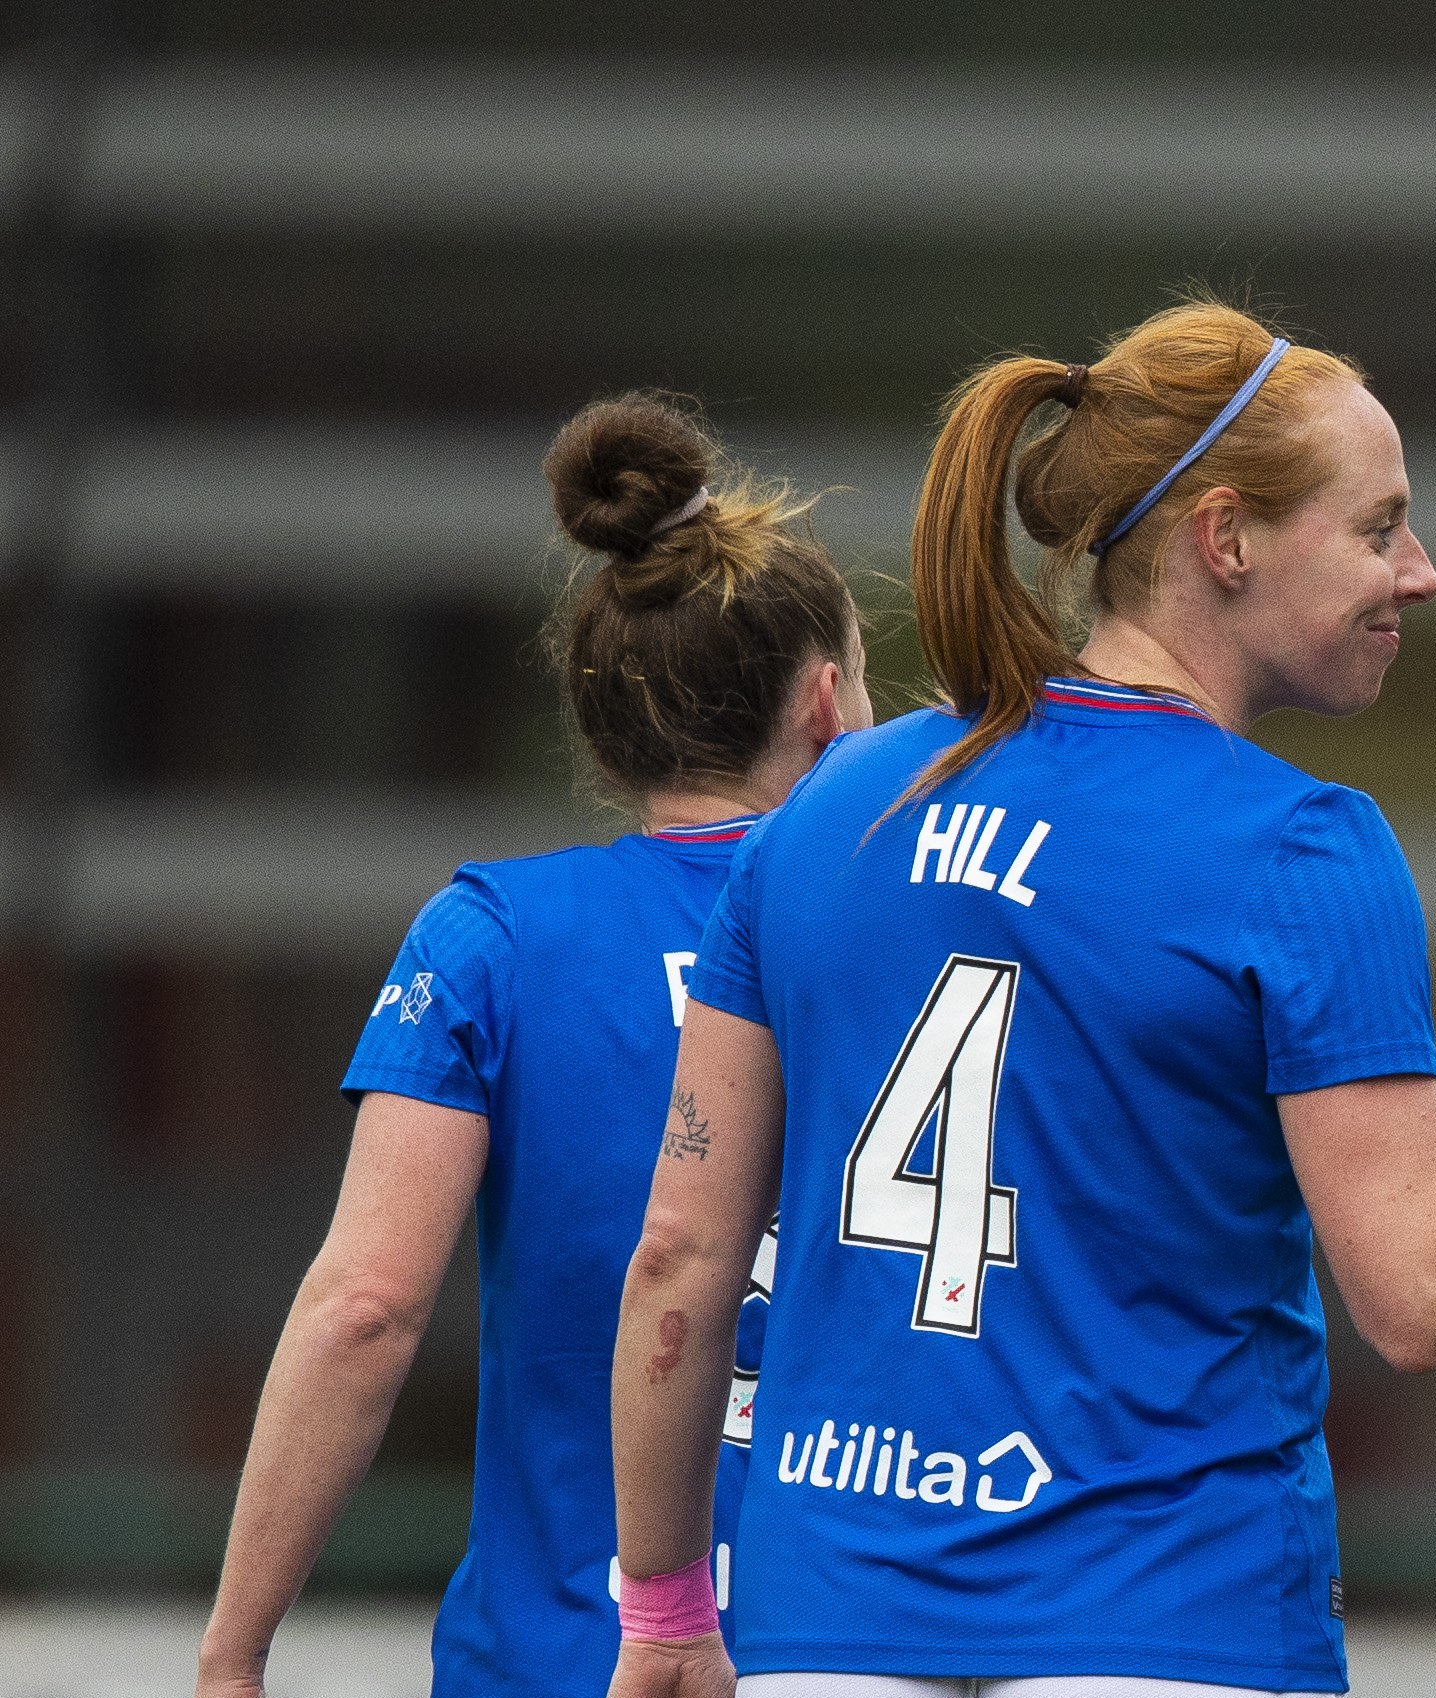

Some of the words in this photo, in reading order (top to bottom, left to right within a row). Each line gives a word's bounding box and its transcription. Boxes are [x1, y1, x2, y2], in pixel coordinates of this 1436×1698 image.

[910, 803, 1051, 907] HILL
[839, 953, 1021, 1340] 4
[778, 1419, 967, 1507] utilita
